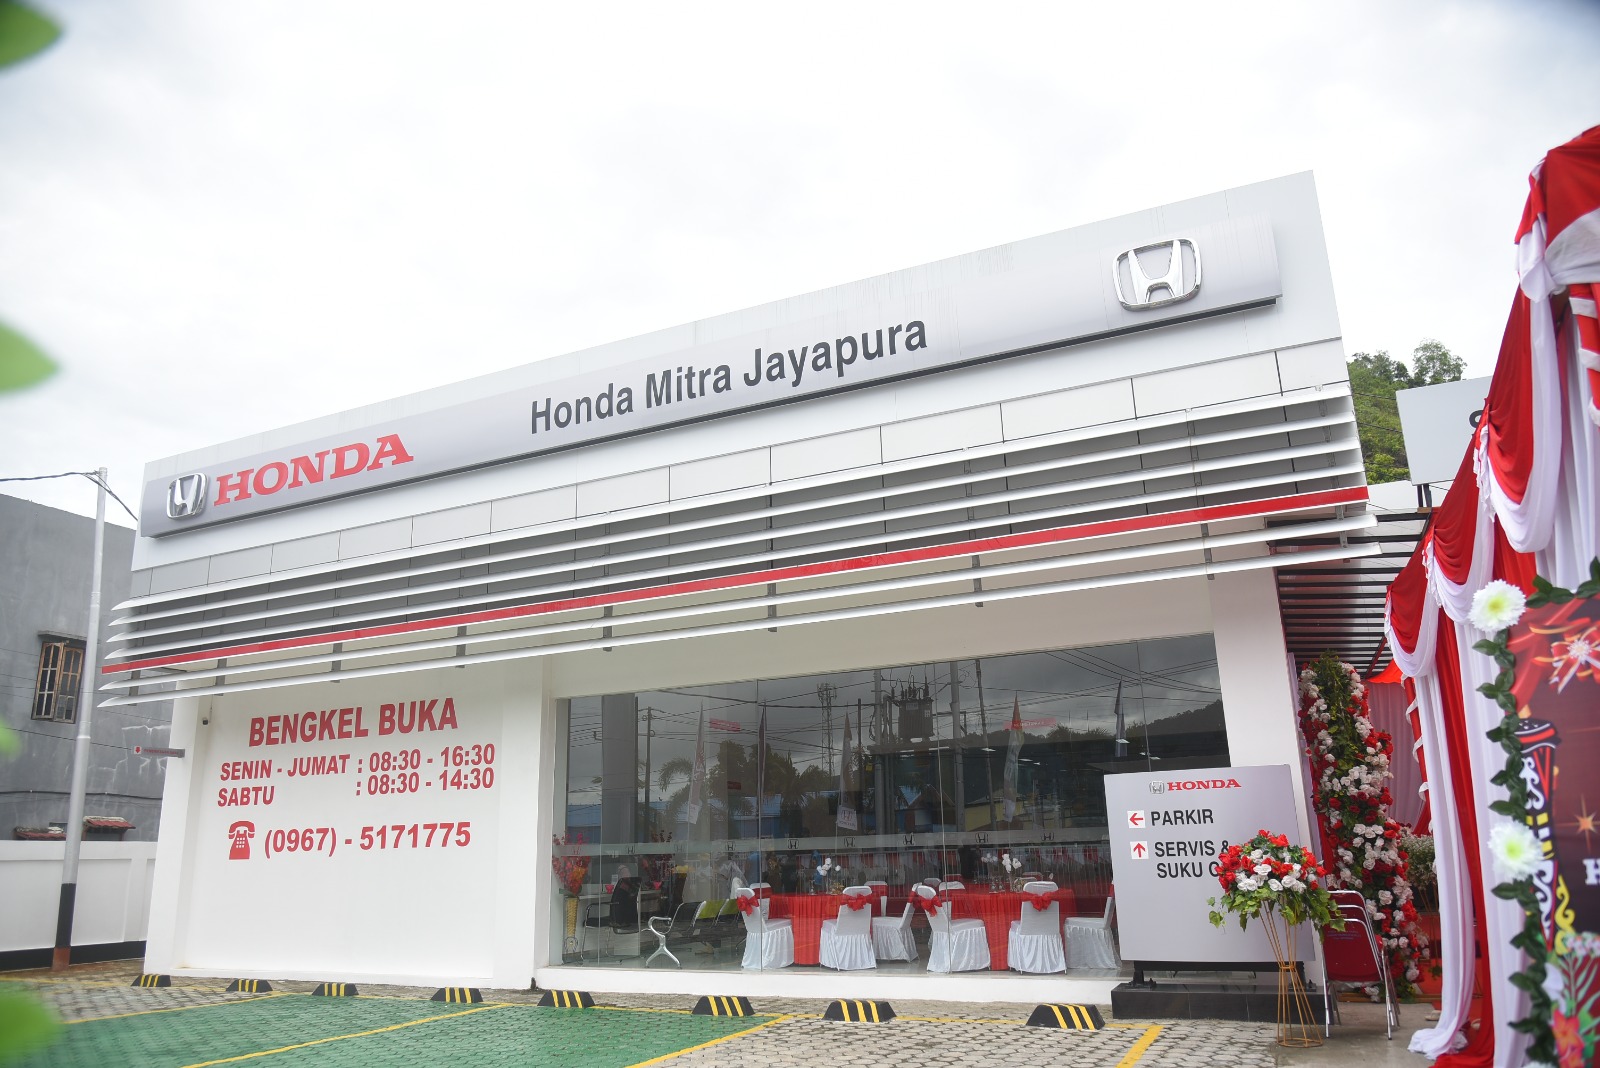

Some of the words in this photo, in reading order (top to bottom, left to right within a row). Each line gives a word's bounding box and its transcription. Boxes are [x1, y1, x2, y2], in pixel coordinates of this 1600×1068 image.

[531, 383, 634, 434] Honda
[645, 364, 732, 409] Mitra
[743, 320, 928, 387] Jayapura
[213, 433, 414, 506] HONDA
[249, 706, 369, 747] BENGKEL
[378, 697, 458, 736] BUKA
[220, 759, 273, 781] SENIN
[287, 754, 351, 777] JUMAT
[369, 748, 421, 773] 08:30
[440, 743, 495, 767] 16:30
[217, 785, 275, 807] SABTU
[367, 771, 420, 796] 08:30
[439, 767, 495, 791] 14:30
[1167, 778, 1242, 791] HONDA
[1151, 808, 1214, 826] PARKIR
[264, 827, 337, 859] (0967)
[360, 822, 471, 850] 5171775
[1154, 840, 1216, 857] SERVIS
[1157, 861, 1204, 878] SUKU
